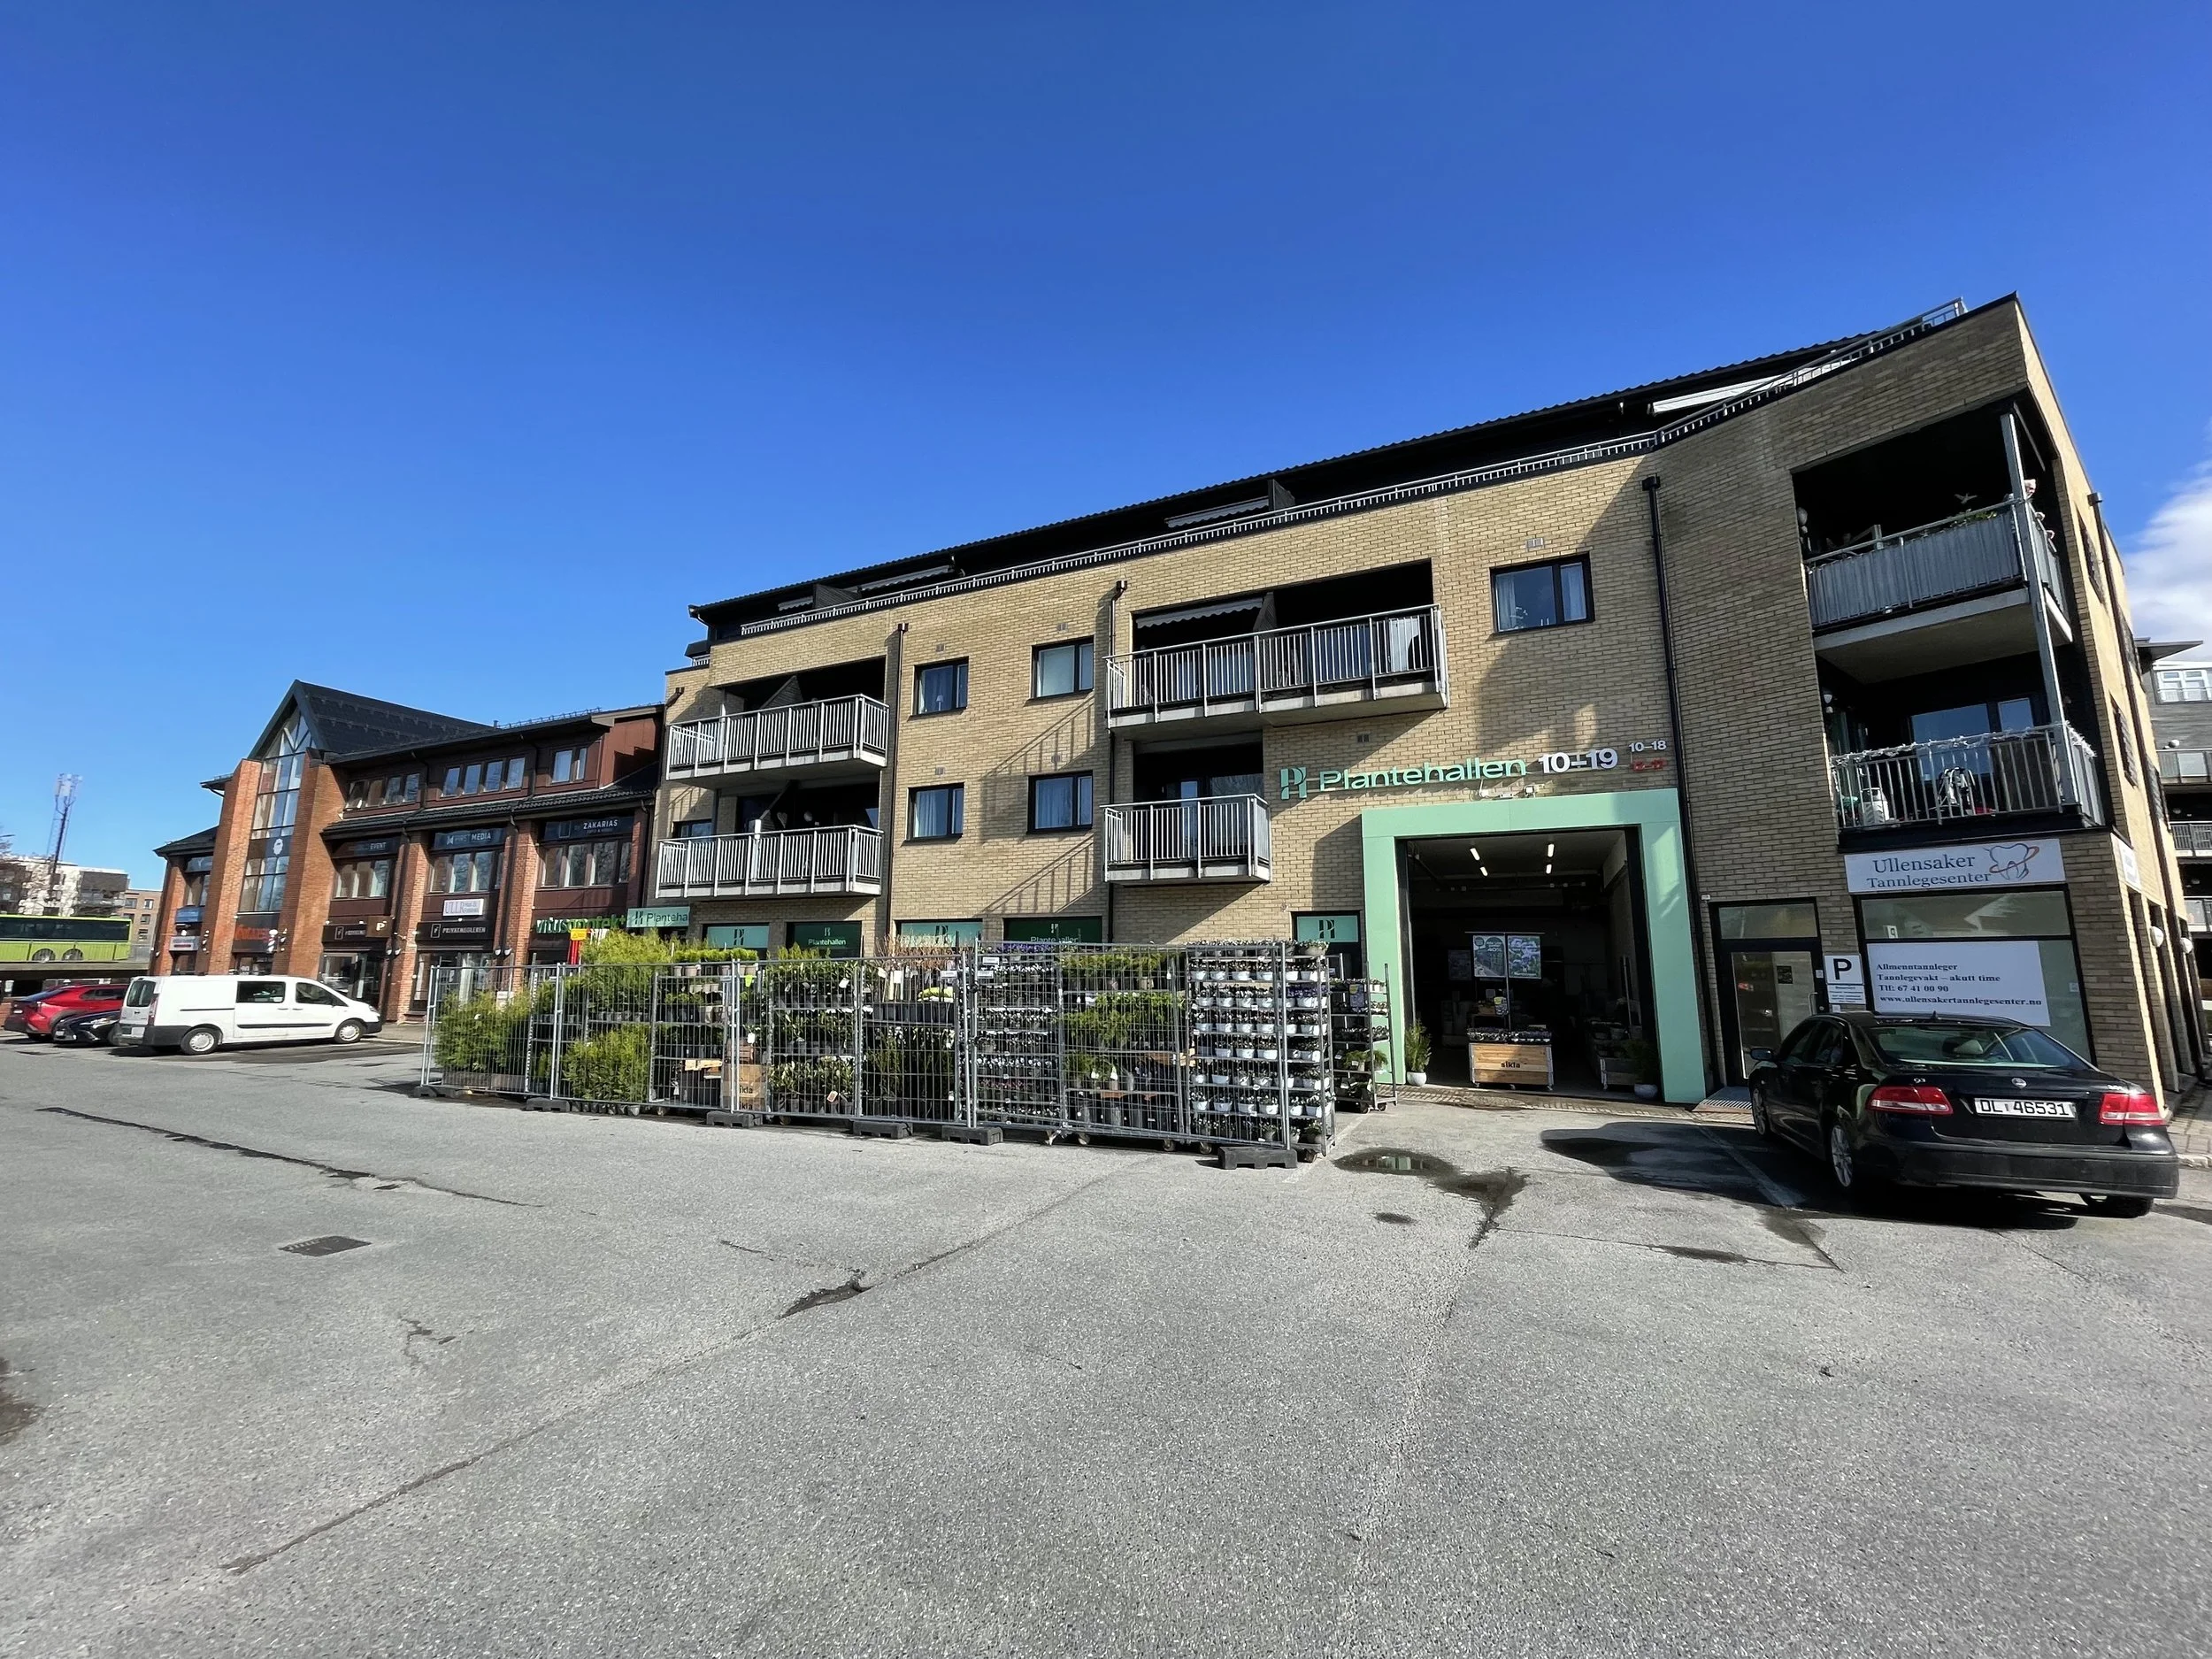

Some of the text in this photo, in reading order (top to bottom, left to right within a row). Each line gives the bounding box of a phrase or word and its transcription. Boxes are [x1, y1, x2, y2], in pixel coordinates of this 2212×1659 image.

[1628, 740, 1667, 752] 10–18
[1319, 757, 1527, 792] Plantehallen
[1538, 748, 1618, 773] 10–19
[583, 819, 618, 830] ZAKARIAS
[471, 832, 492, 841] MEDIA
[1872, 855, 1976, 873] Ullensaker
[1867, 872, 1991, 888] Tannlegesenter
[1832, 958, 1852, 980] P
[1880, 996, 2042, 1006] www.ullensakertannlegesenter.no
[1980, 1099, 2070, 1116] DL 46531
